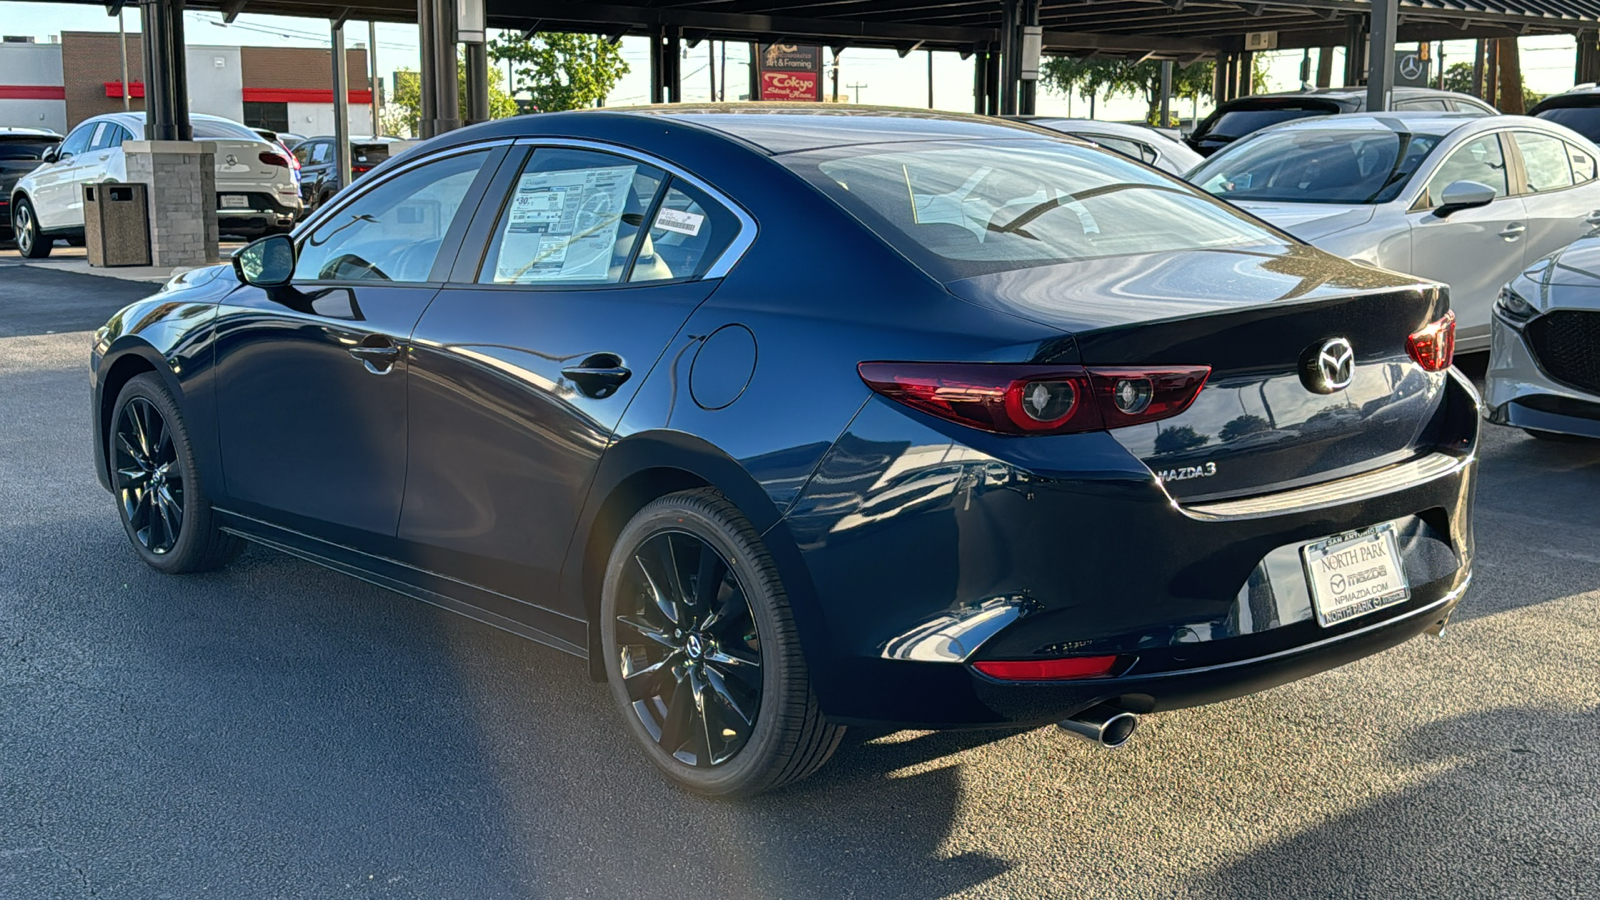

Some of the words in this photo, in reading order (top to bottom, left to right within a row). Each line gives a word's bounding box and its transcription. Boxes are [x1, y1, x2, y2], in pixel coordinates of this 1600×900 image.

[766, 59, 778, 67] Art
[778, 59, 784, 67] &
[784, 59, 811, 69] Framing
[764, 73, 813, 91] Tokyo
[764, 87, 791, 95] Steak
[1158, 462, 1216, 481] MAZDA3
[1328, 537, 1342, 546] SAN
[1321, 550, 1358, 573] NORTH
[1360, 542, 1386, 561] PARK
[1335, 583, 1388, 605] NPMAZDA.COM
[1326, 607, 1352, 623] NORTH
[1352, 599, 1373, 615] PARK
